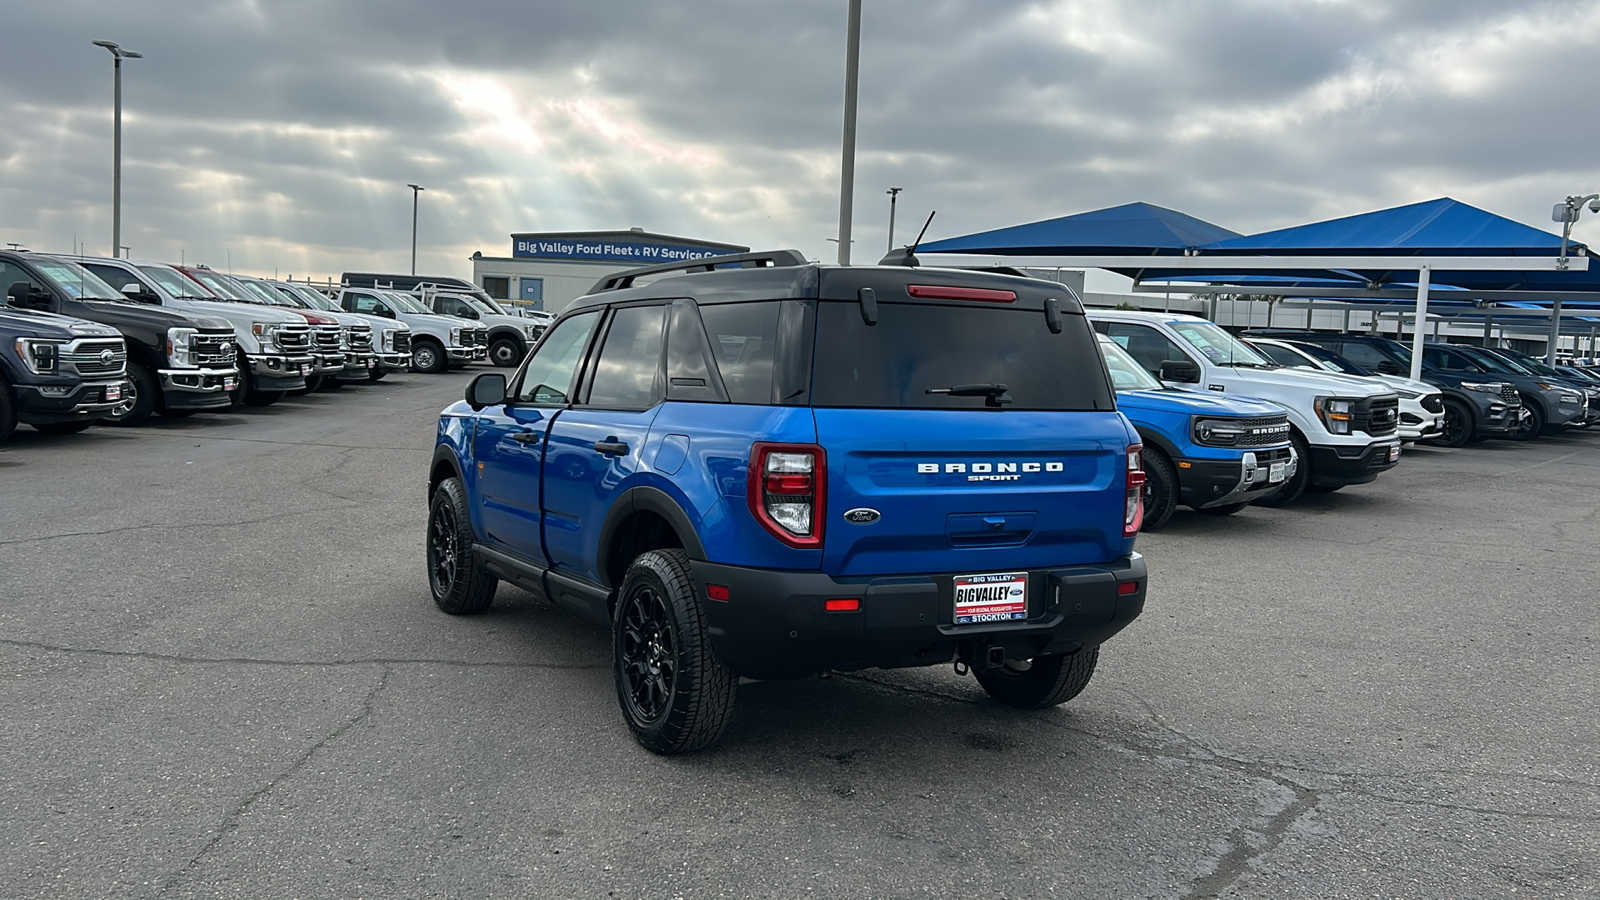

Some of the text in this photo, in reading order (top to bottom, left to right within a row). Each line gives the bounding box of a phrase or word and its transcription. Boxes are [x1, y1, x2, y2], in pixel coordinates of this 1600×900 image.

[518, 242, 537, 253] Big
[539, 242, 574, 255] Valley
[576, 244, 601, 254] Ford
[604, 245, 633, 255] Fleet
[634, 248, 640, 256] &
[643, 247, 659, 257] RV
[661, 248, 702, 260] Service
[917, 462, 1064, 473] BRONCO
[967, 474, 1021, 482] SPORT
[956, 586, 1010, 602] BIGVALLEY
[972, 613, 1011, 622] STOCKTON
